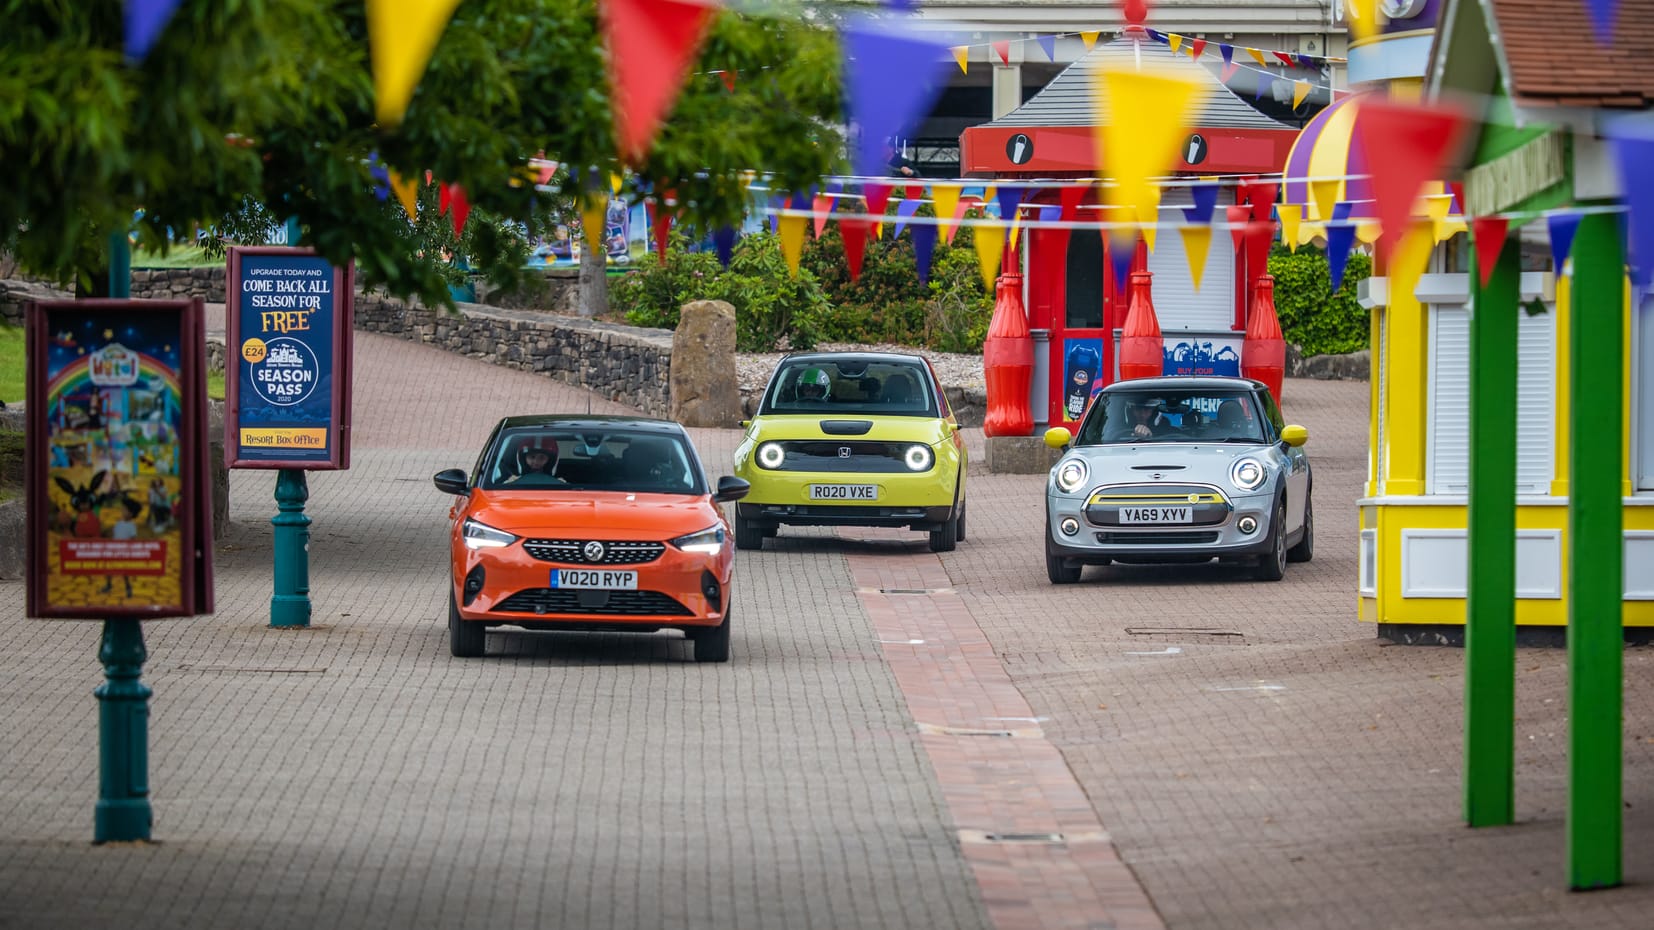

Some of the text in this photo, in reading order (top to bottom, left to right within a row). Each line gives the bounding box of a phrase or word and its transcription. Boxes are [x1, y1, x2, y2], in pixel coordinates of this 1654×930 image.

[250, 268, 282, 276] UPGRADE
[243, 280, 330, 293] COME BACK ALL
[252, 294, 321, 309] SEASON FOR
[245, 347, 264, 357] £24
[258, 369, 312, 383] SEASON
[1177, 367, 1192, 375] BUY
[267, 383, 303, 396] PASS
[246, 434, 320, 445] Resort Box Office
[815, 486, 873, 498] RO20 VXE
[1125, 508, 1187, 521] YA69 XYV
[560, 570, 632, 586] VO20 RYP
